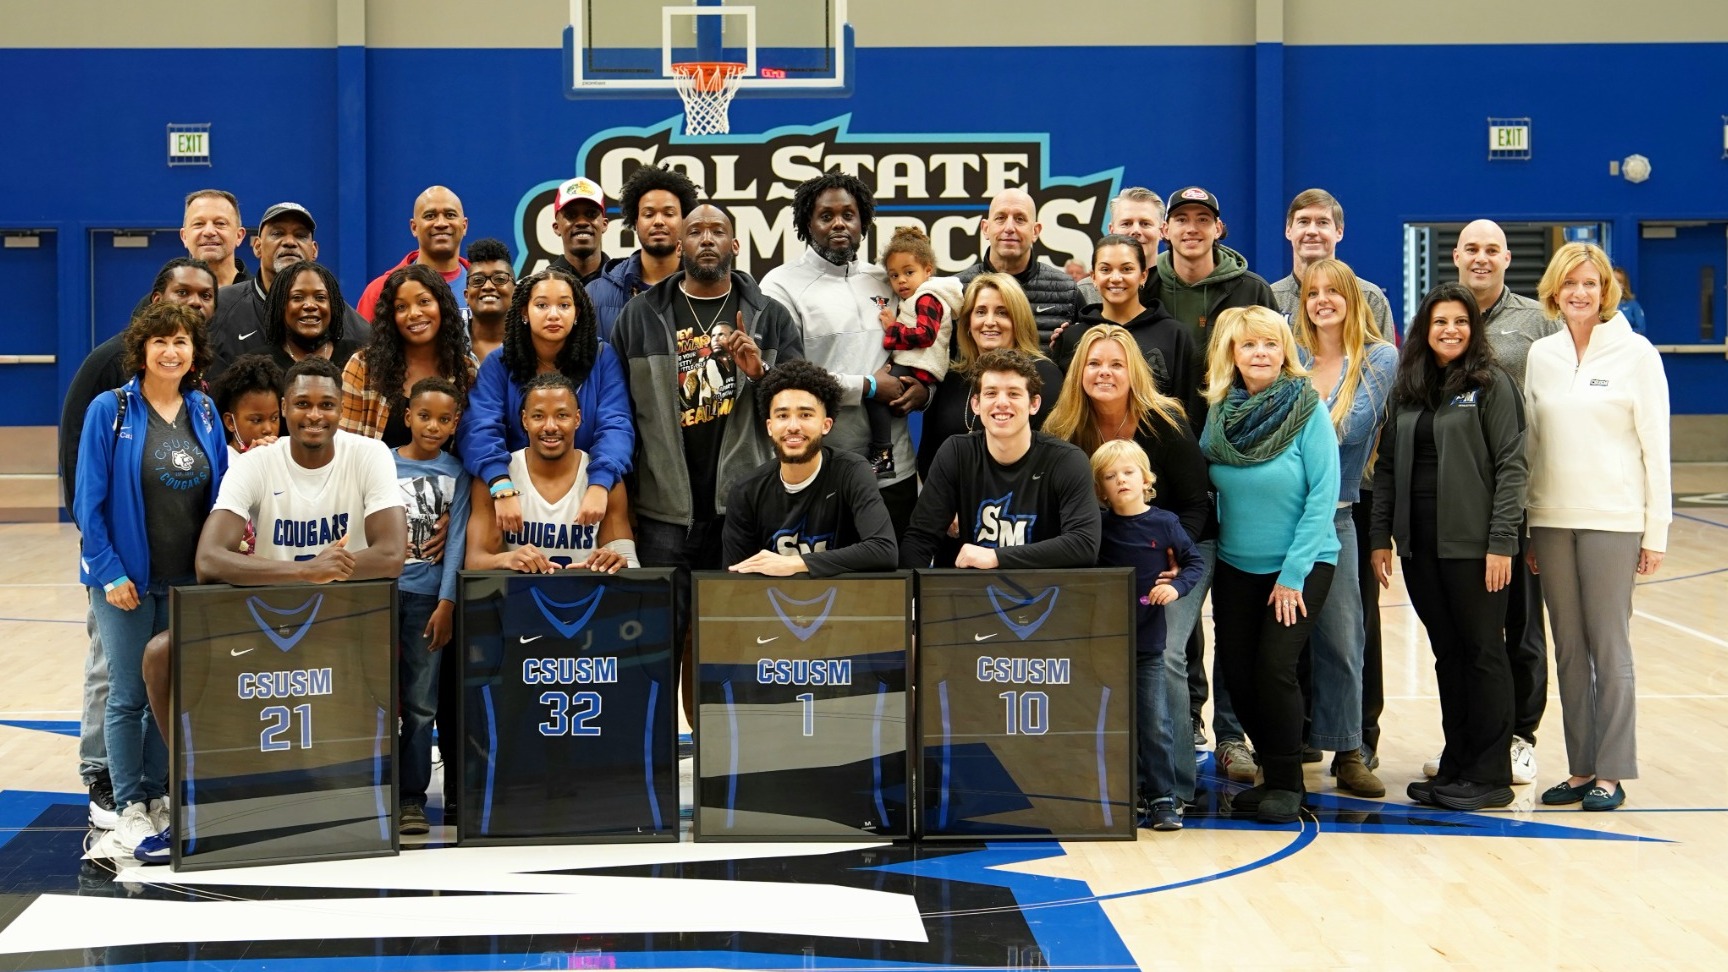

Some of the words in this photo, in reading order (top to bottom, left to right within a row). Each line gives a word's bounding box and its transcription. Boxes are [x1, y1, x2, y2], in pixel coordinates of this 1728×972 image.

[178, 134, 203, 153] EXIT
[1498, 128, 1523, 147] EXIT
[766, 141, 1028, 201] STATE
[155, 439, 205, 460] CSUSM
[160, 471, 207, 490] COUGARS
[273, 512, 349, 548] COUGARS
[976, 505, 1028, 548] SM
[237, 667, 332, 699] CSUSM
[522, 656, 618, 685] CSUSM
[757, 658, 852, 685] CSUSM
[976, 655, 1071, 685] CSUSM
[260, 703, 312, 752] 21
[538, 691, 602, 736] 32
[796, 693, 814, 737] 1
[999, 691, 1049, 736] 10
